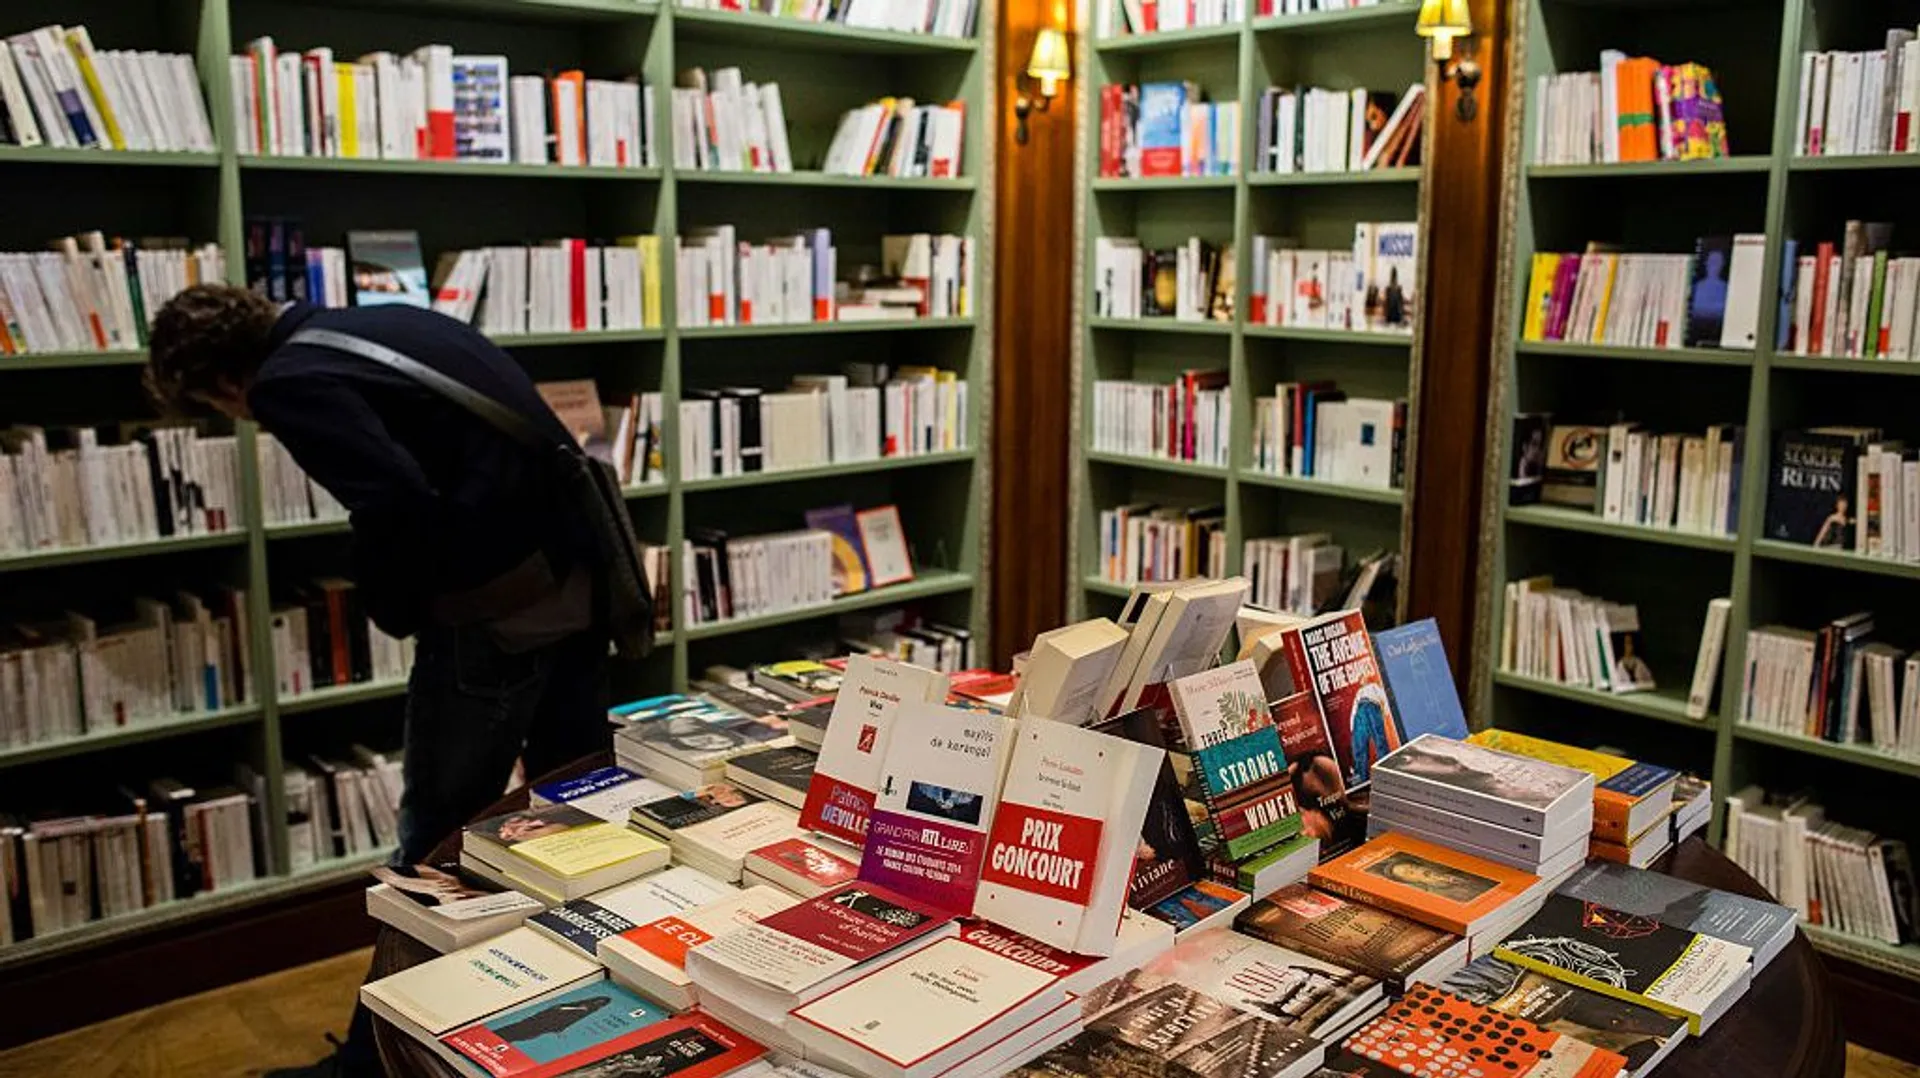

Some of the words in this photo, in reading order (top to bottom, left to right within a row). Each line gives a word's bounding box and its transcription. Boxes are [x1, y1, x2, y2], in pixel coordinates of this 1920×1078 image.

[1309, 641, 1335, 671] THE
[1317, 672, 1331, 696] OF
[1329, 664, 1350, 691] THE
[929, 737, 943, 748] de
[1218, 750, 1279, 792] STRONG
[820, 803, 871, 836] DEVILLE
[1244, 791, 1298, 832] WOMEN
[873, 820, 902, 838] GRAND
[920, 828, 941, 847] RTL
[1021, 817, 1064, 853] PRIX
[991, 842, 1084, 890] GONCOURT
[653, 920, 685, 935] LE
[676, 930, 703, 948] CL
[966, 929, 1072, 974] GONCOURT
[1225, 961, 1291, 998] 1914
